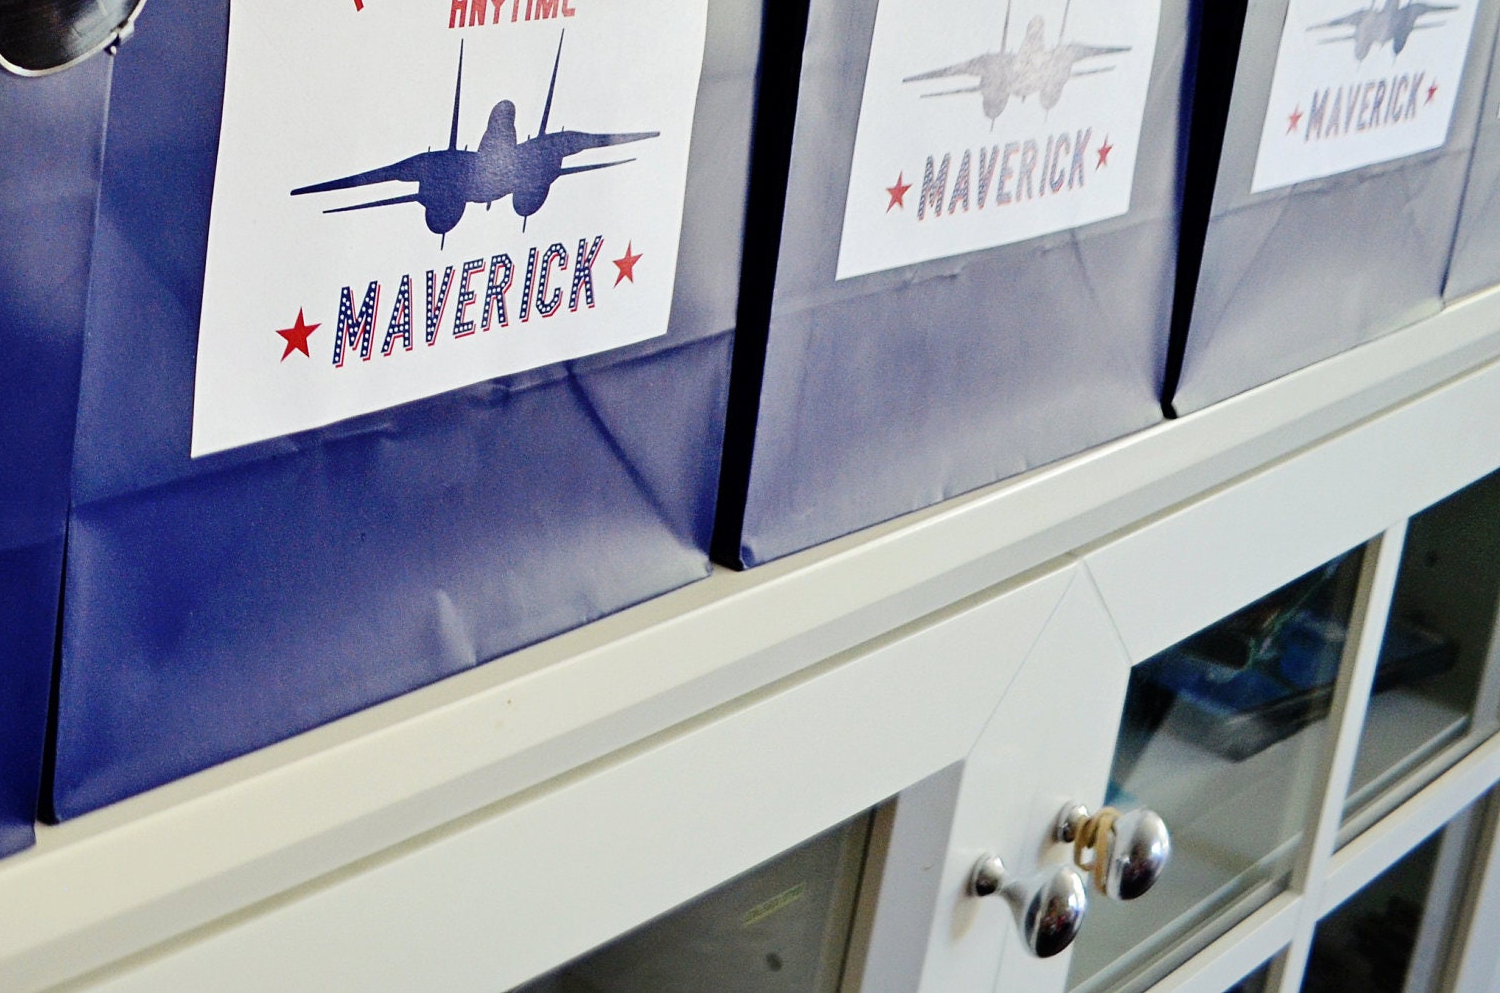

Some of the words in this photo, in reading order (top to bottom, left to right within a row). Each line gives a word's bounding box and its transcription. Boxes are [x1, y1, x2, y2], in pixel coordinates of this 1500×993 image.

[1304, 70, 1426, 143] MAVERICK
[916, 126, 1093, 222] MAVERICK
[332, 234, 604, 369] MAVERICK
